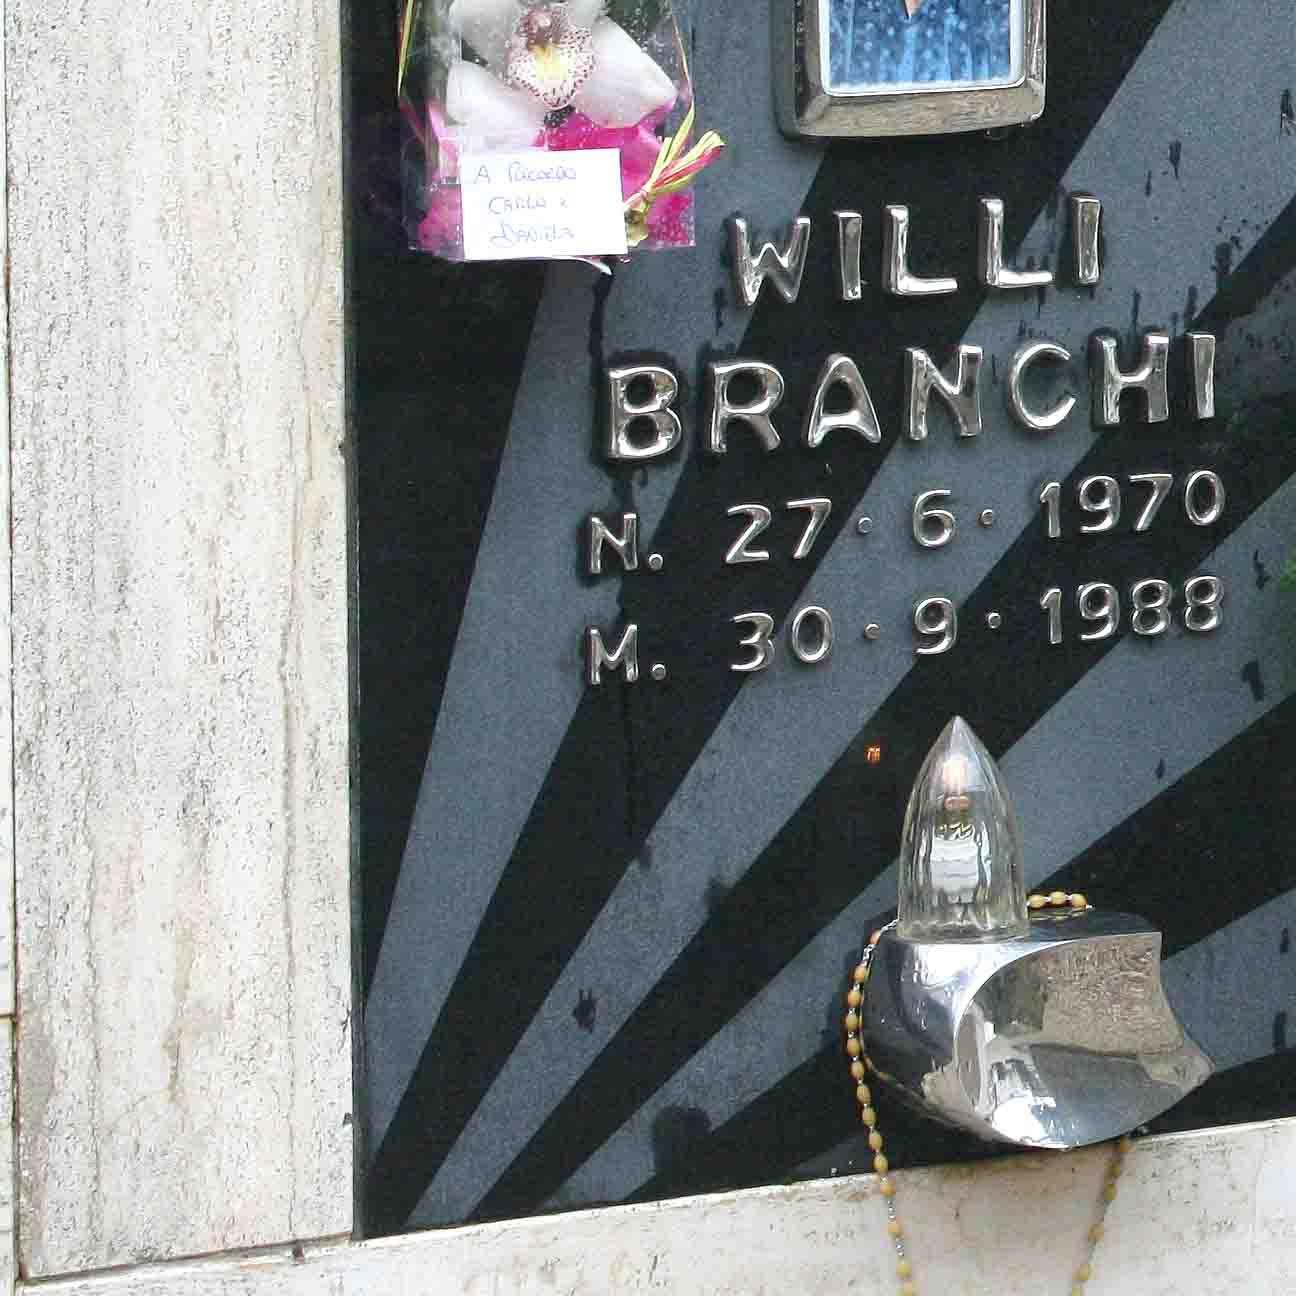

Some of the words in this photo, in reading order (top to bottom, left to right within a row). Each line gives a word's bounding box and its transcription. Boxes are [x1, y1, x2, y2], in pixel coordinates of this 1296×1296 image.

[730, 195, 1104, 306] WILLI
[606, 331, 1218, 461] BRANCHI
[589, 512, 664, 574] N.
[588, 623, 667, 685] M.
